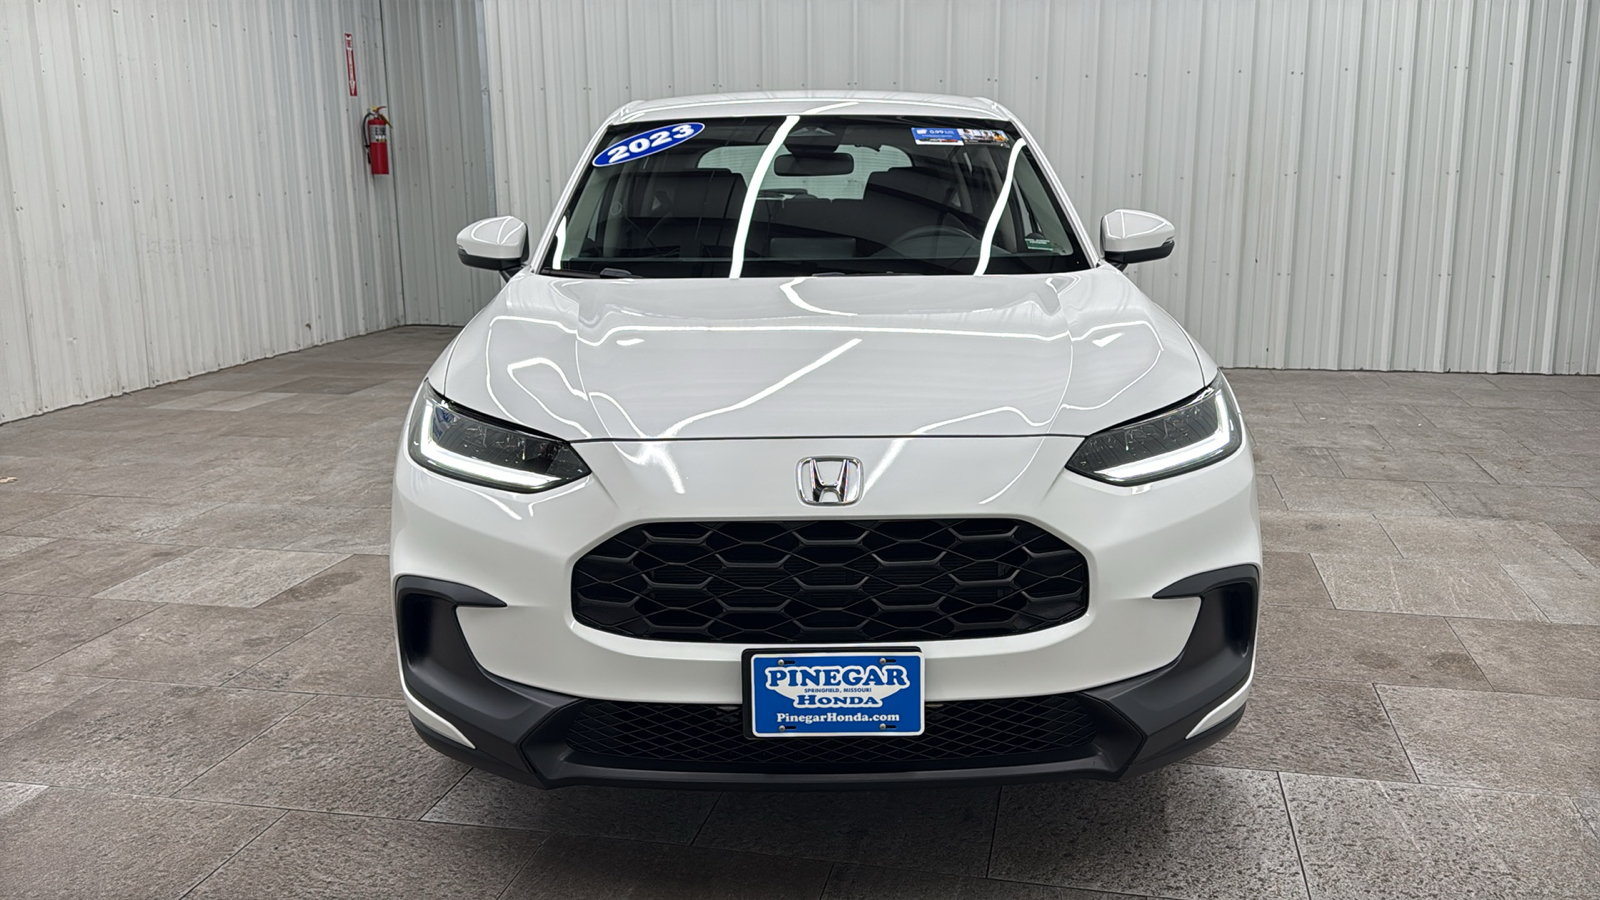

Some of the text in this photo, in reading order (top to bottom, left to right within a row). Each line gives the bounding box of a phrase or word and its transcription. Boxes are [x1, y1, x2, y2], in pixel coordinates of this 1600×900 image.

[607, 124, 695, 164] 2023
[767, 667, 909, 688] PINEGAR
[796, 694, 880, 706] HONDA
[776, 712, 900, 724] PinegarHonda.com
